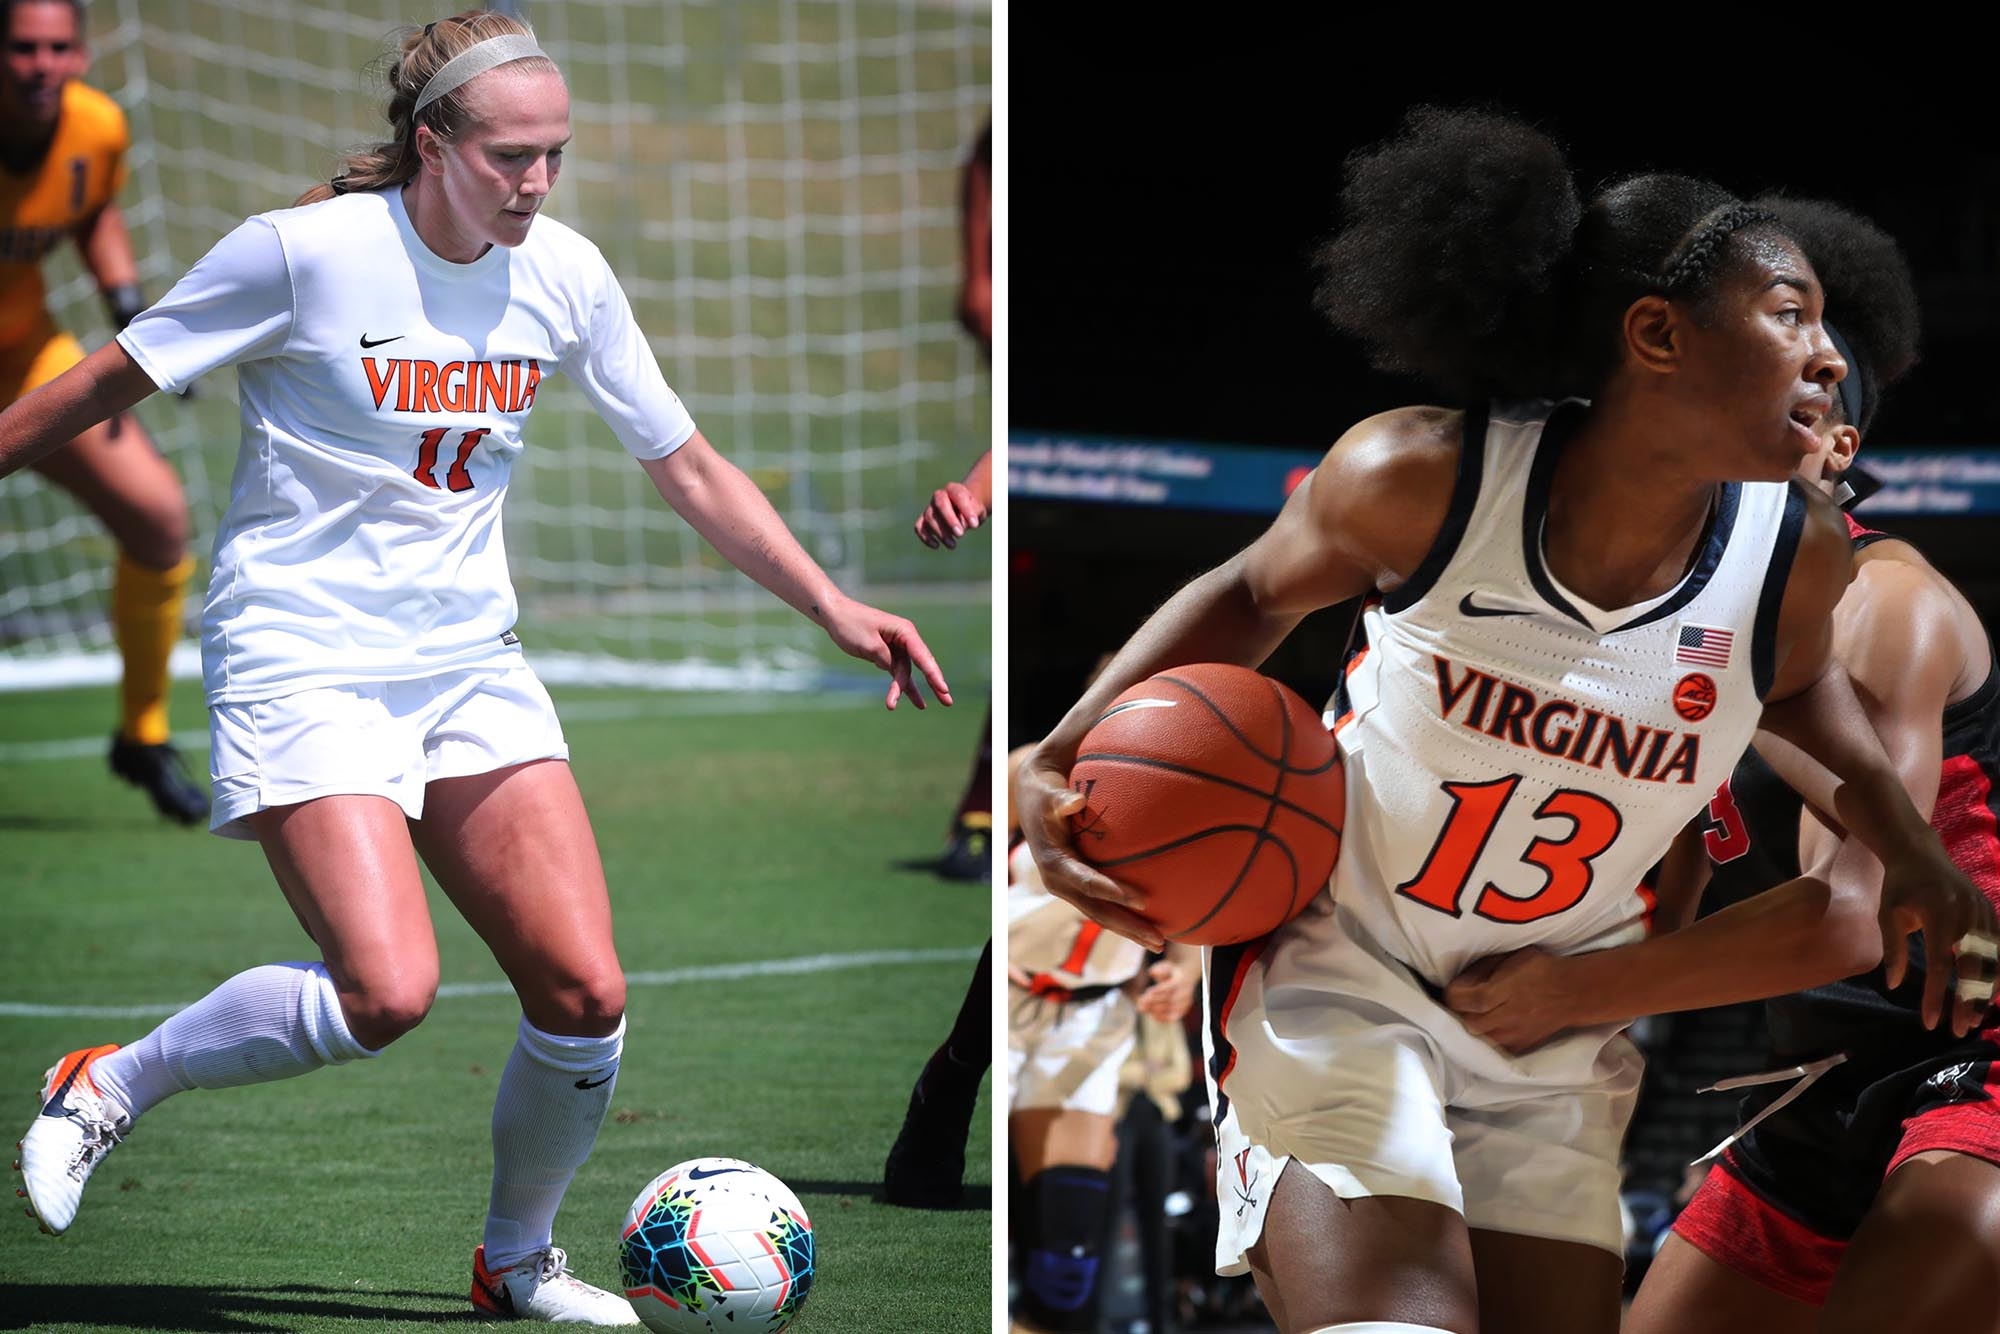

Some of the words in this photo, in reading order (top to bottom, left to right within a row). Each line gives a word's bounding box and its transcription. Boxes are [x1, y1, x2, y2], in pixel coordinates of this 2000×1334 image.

[361, 357, 541, 413] VIRGINIA
[413, 428, 491, 492] 11
[1432, 654, 1701, 784] VIRGINIA
[1395, 773, 1623, 924] 13
